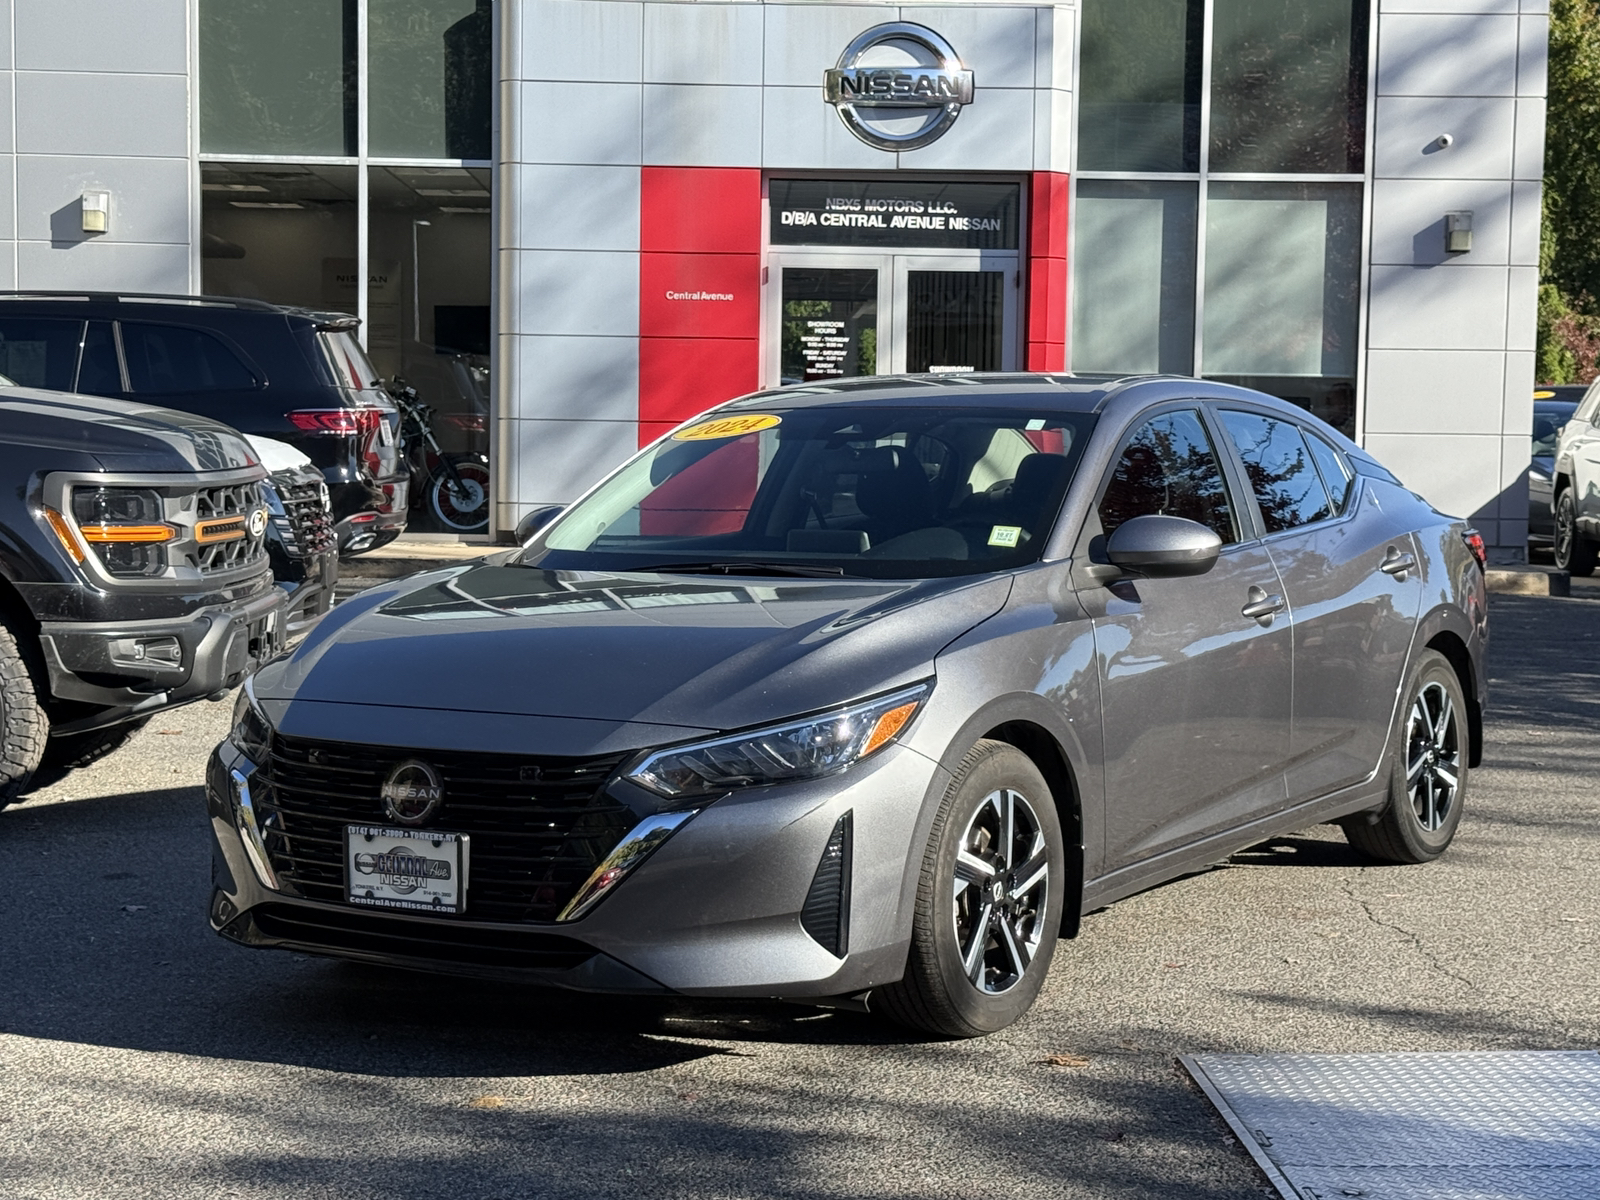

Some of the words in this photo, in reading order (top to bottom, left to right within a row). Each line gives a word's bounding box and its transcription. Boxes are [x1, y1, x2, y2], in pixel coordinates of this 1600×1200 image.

[838, 75, 959, 97] NISSAN
[864, 199, 925, 213] MOTORS
[927, 201, 958, 214] LLC.
[781, 211, 817, 226] D/B/A
[820, 213, 887, 228] CENTRAL
[890, 215, 945, 230] AVENUE
[948, 217, 1001, 231] NISSAN
[336, 275, 388, 283] NISAN
[665, 290, 700, 300] Central
[700, 291, 734, 301] Avenue
[684, 417, 768, 438] 2024
[384, 786, 440, 799] NISSAN
[378, 853, 428, 876] CENTRAL
[380, 873, 428, 889] NISSAN
[350, 896, 456, 913] CentralAveNissan.com
